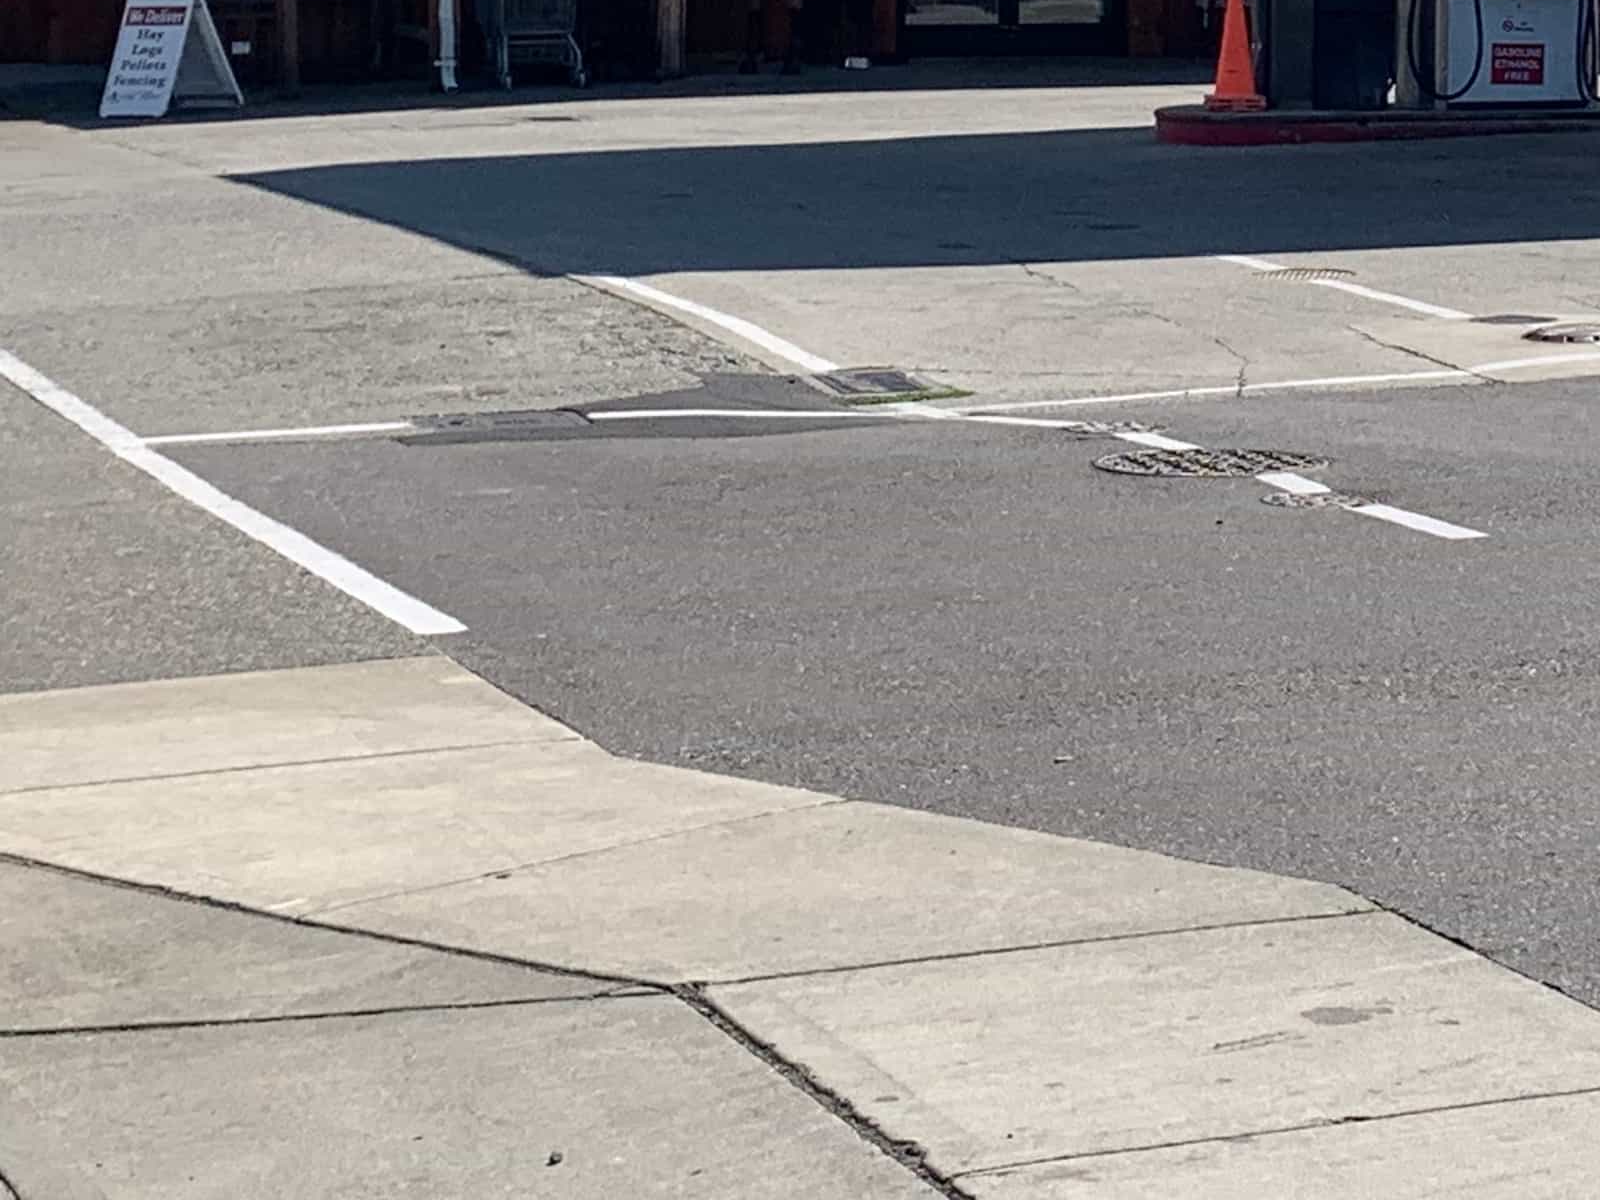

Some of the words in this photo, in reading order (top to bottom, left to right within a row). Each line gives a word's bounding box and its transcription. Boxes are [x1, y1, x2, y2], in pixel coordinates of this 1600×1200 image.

[137, 29, 165, 42] Hay
[131, 43, 163, 58] Logs
[120, 59, 167, 71] Pellets
[113, 74, 167, 88] Fencing
[1504, 71, 1530, 81] FREE
